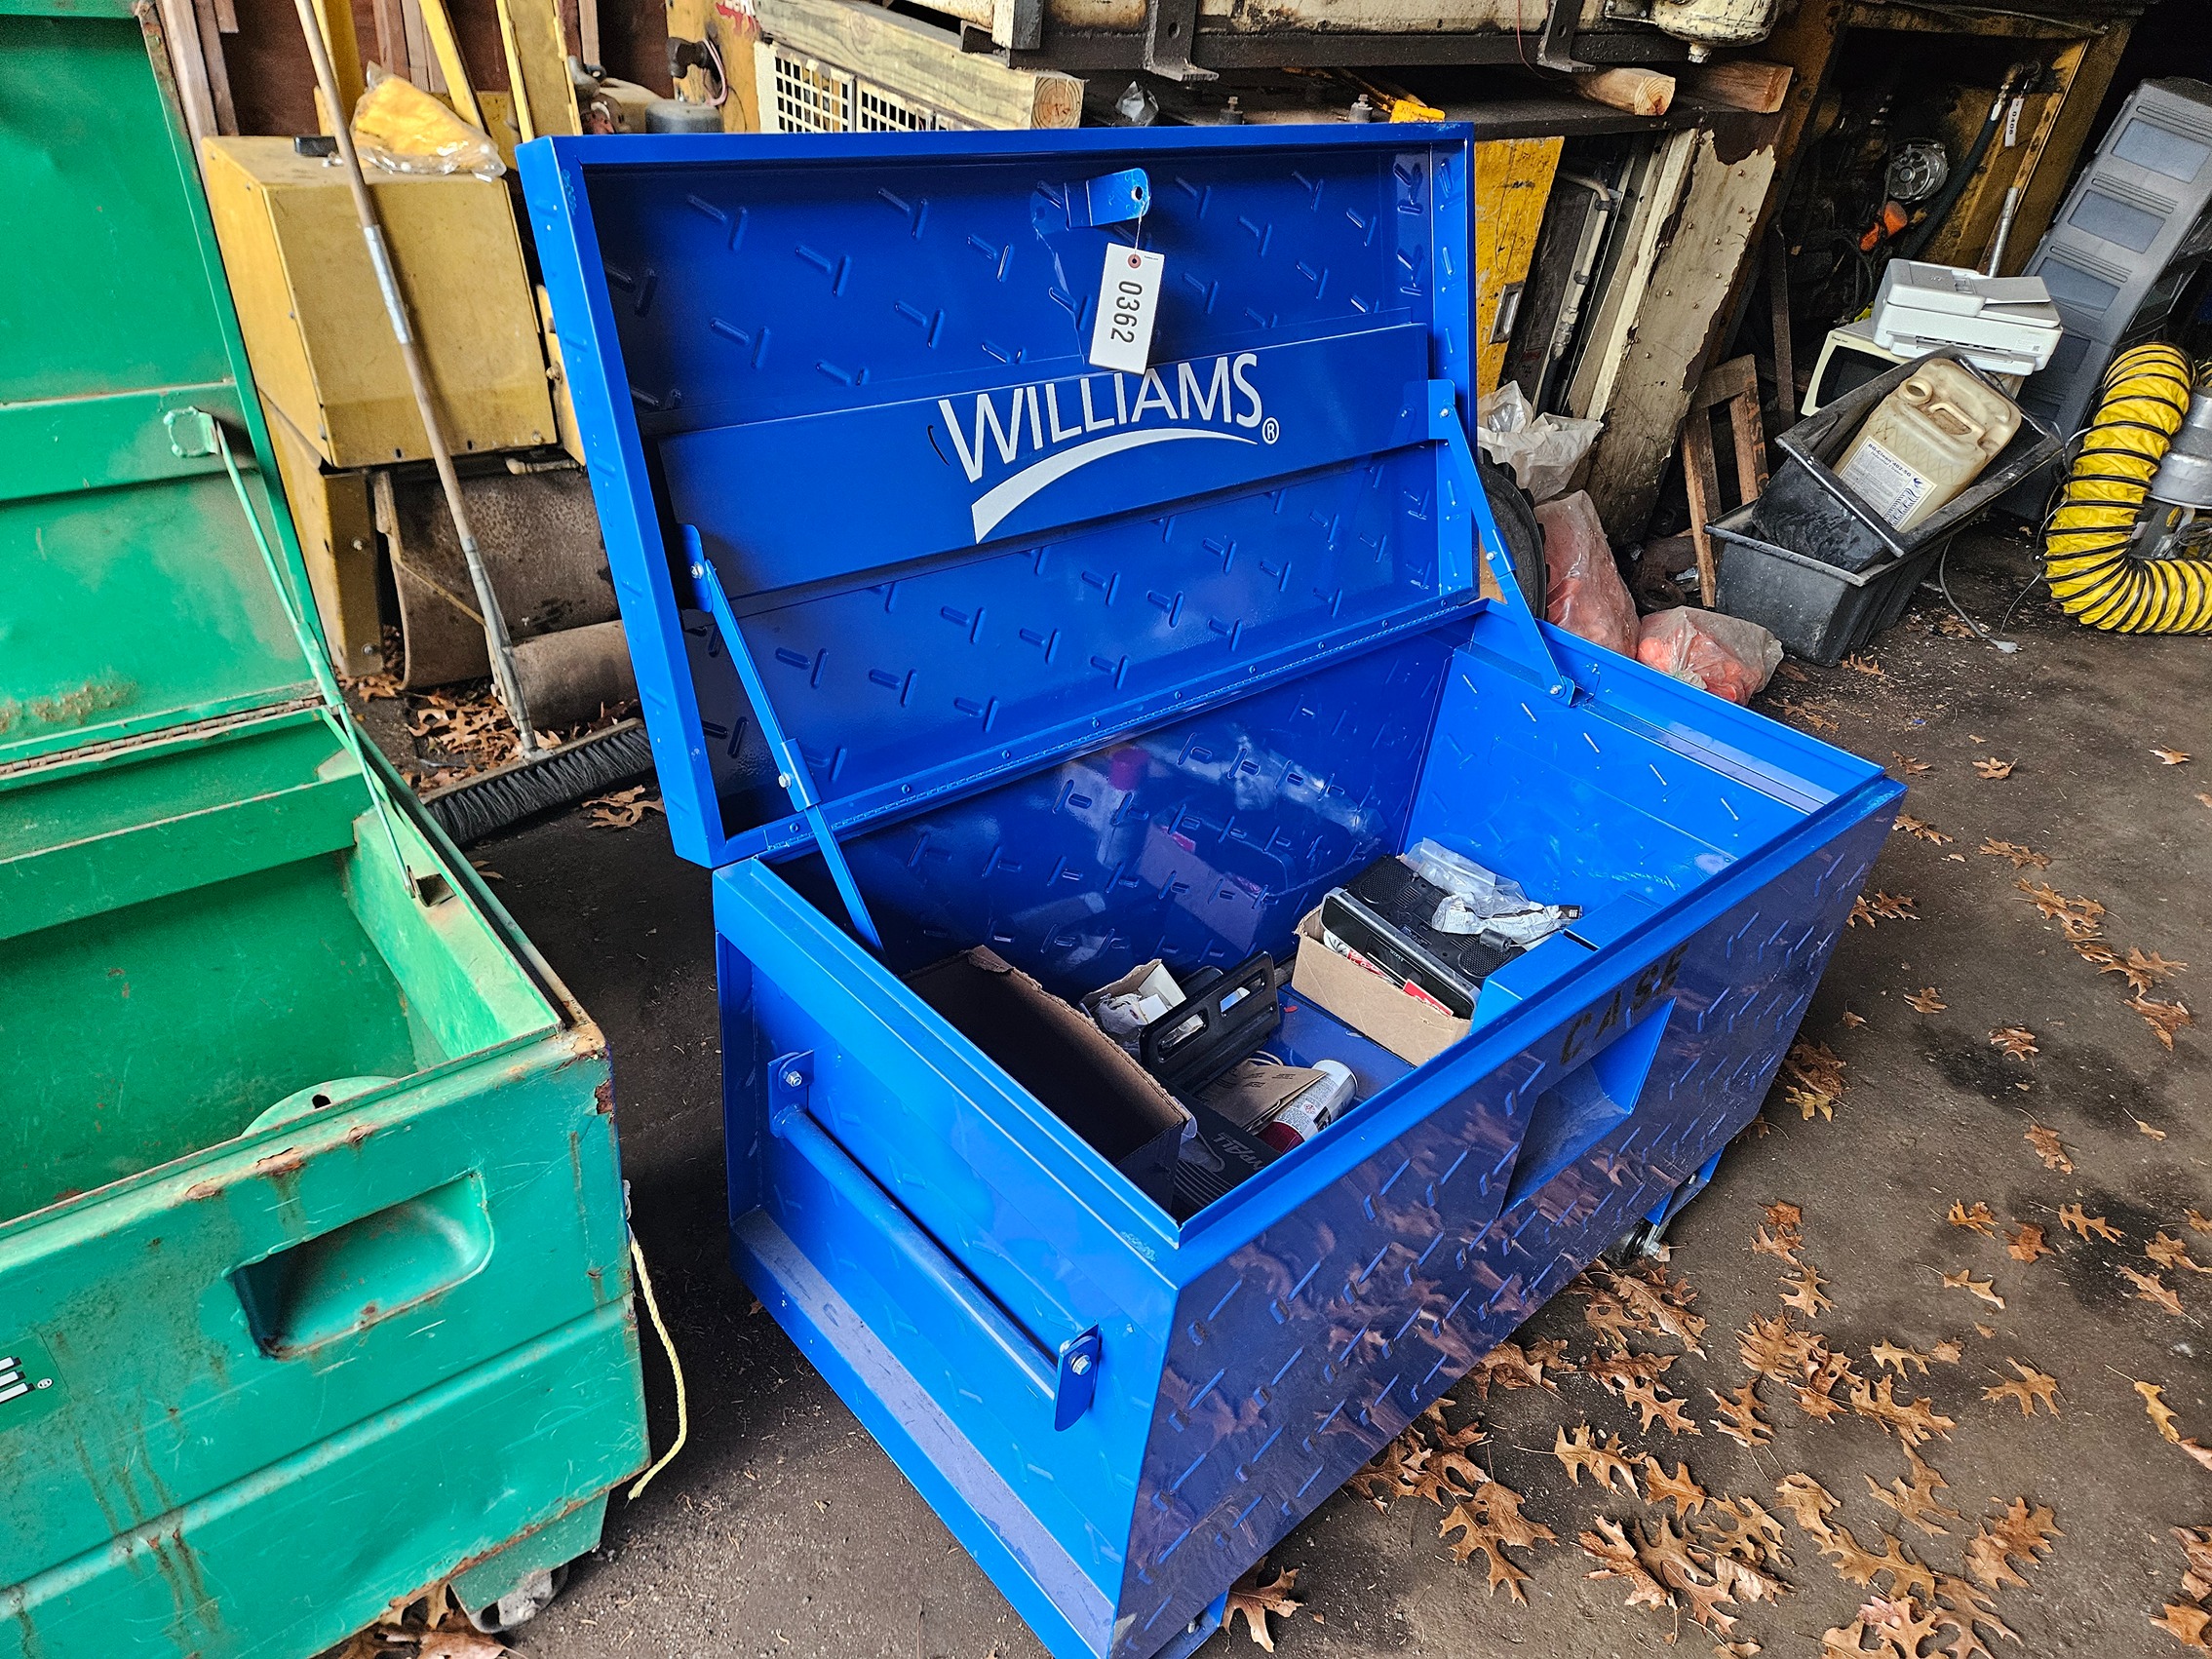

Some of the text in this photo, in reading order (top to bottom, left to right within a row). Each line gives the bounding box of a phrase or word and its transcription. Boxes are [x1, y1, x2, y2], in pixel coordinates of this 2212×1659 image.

[1110, 281, 1143, 343] 0362
[938, 353, 1262, 482] WILLIAMS
[1561, 943, 1688, 1064] CASE
